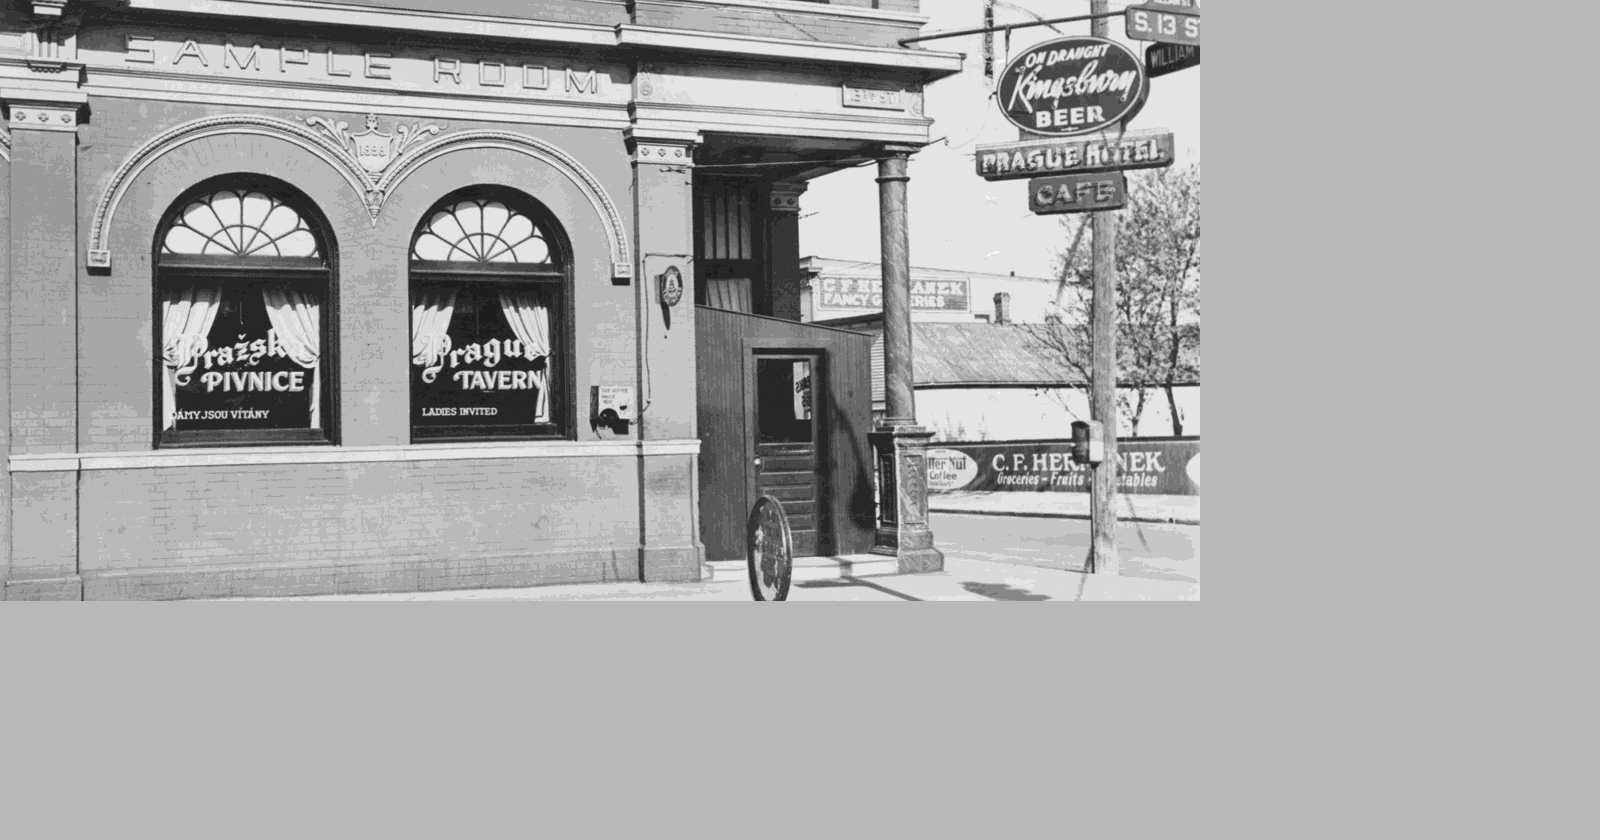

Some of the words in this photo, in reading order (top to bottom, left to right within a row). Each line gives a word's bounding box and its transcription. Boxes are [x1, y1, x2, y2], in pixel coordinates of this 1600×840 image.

[1134, 11, 1152, 33] S.
[1157, 13, 1176, 35] 13
[1184, 17, 1200, 38] S
[125, 36, 393, 81] SAMPLE
[432, 57, 598, 95] ROOM
[1025, 51, 1047, 68] ON
[1046, 43, 1111, 66] DRAUGHT
[1150, 45, 1194, 69] WILLIAM
[1007, 59, 1137, 114] Kingsbury
[1036, 105, 1106, 128] BEER
[981, 146, 1082, 173] PRAGUE
[1085, 139, 1164, 166] HOTEL
[1036, 180, 1116, 206] CAFE
[857, 279, 964, 295] HEANEK
[823, 293, 870, 306] FANCY
[872, 294, 945, 308] GERIES
[174, 327, 290, 386] Pražsk
[200, 370, 305, 392] PIVNICE
[453, 370, 542, 391] TAVERN
[201, 410, 228, 420] JSOU
[230, 407, 270, 419] VÍTÁNY
[422, 408, 458, 417] LADIES
[460, 407, 498, 416] INVITED
[928, 456, 946, 470] tter
[992, 453, 1009, 471] C.
[1013, 453, 1028, 471] F.
[1032, 451, 1166, 472] HERNEK
[929, 471, 957, 480] Coffee
[997, 471, 1040, 485] Groceries
[1050, 471, 1085, 486] Fruits
[1116, 472, 1158, 487] tables
